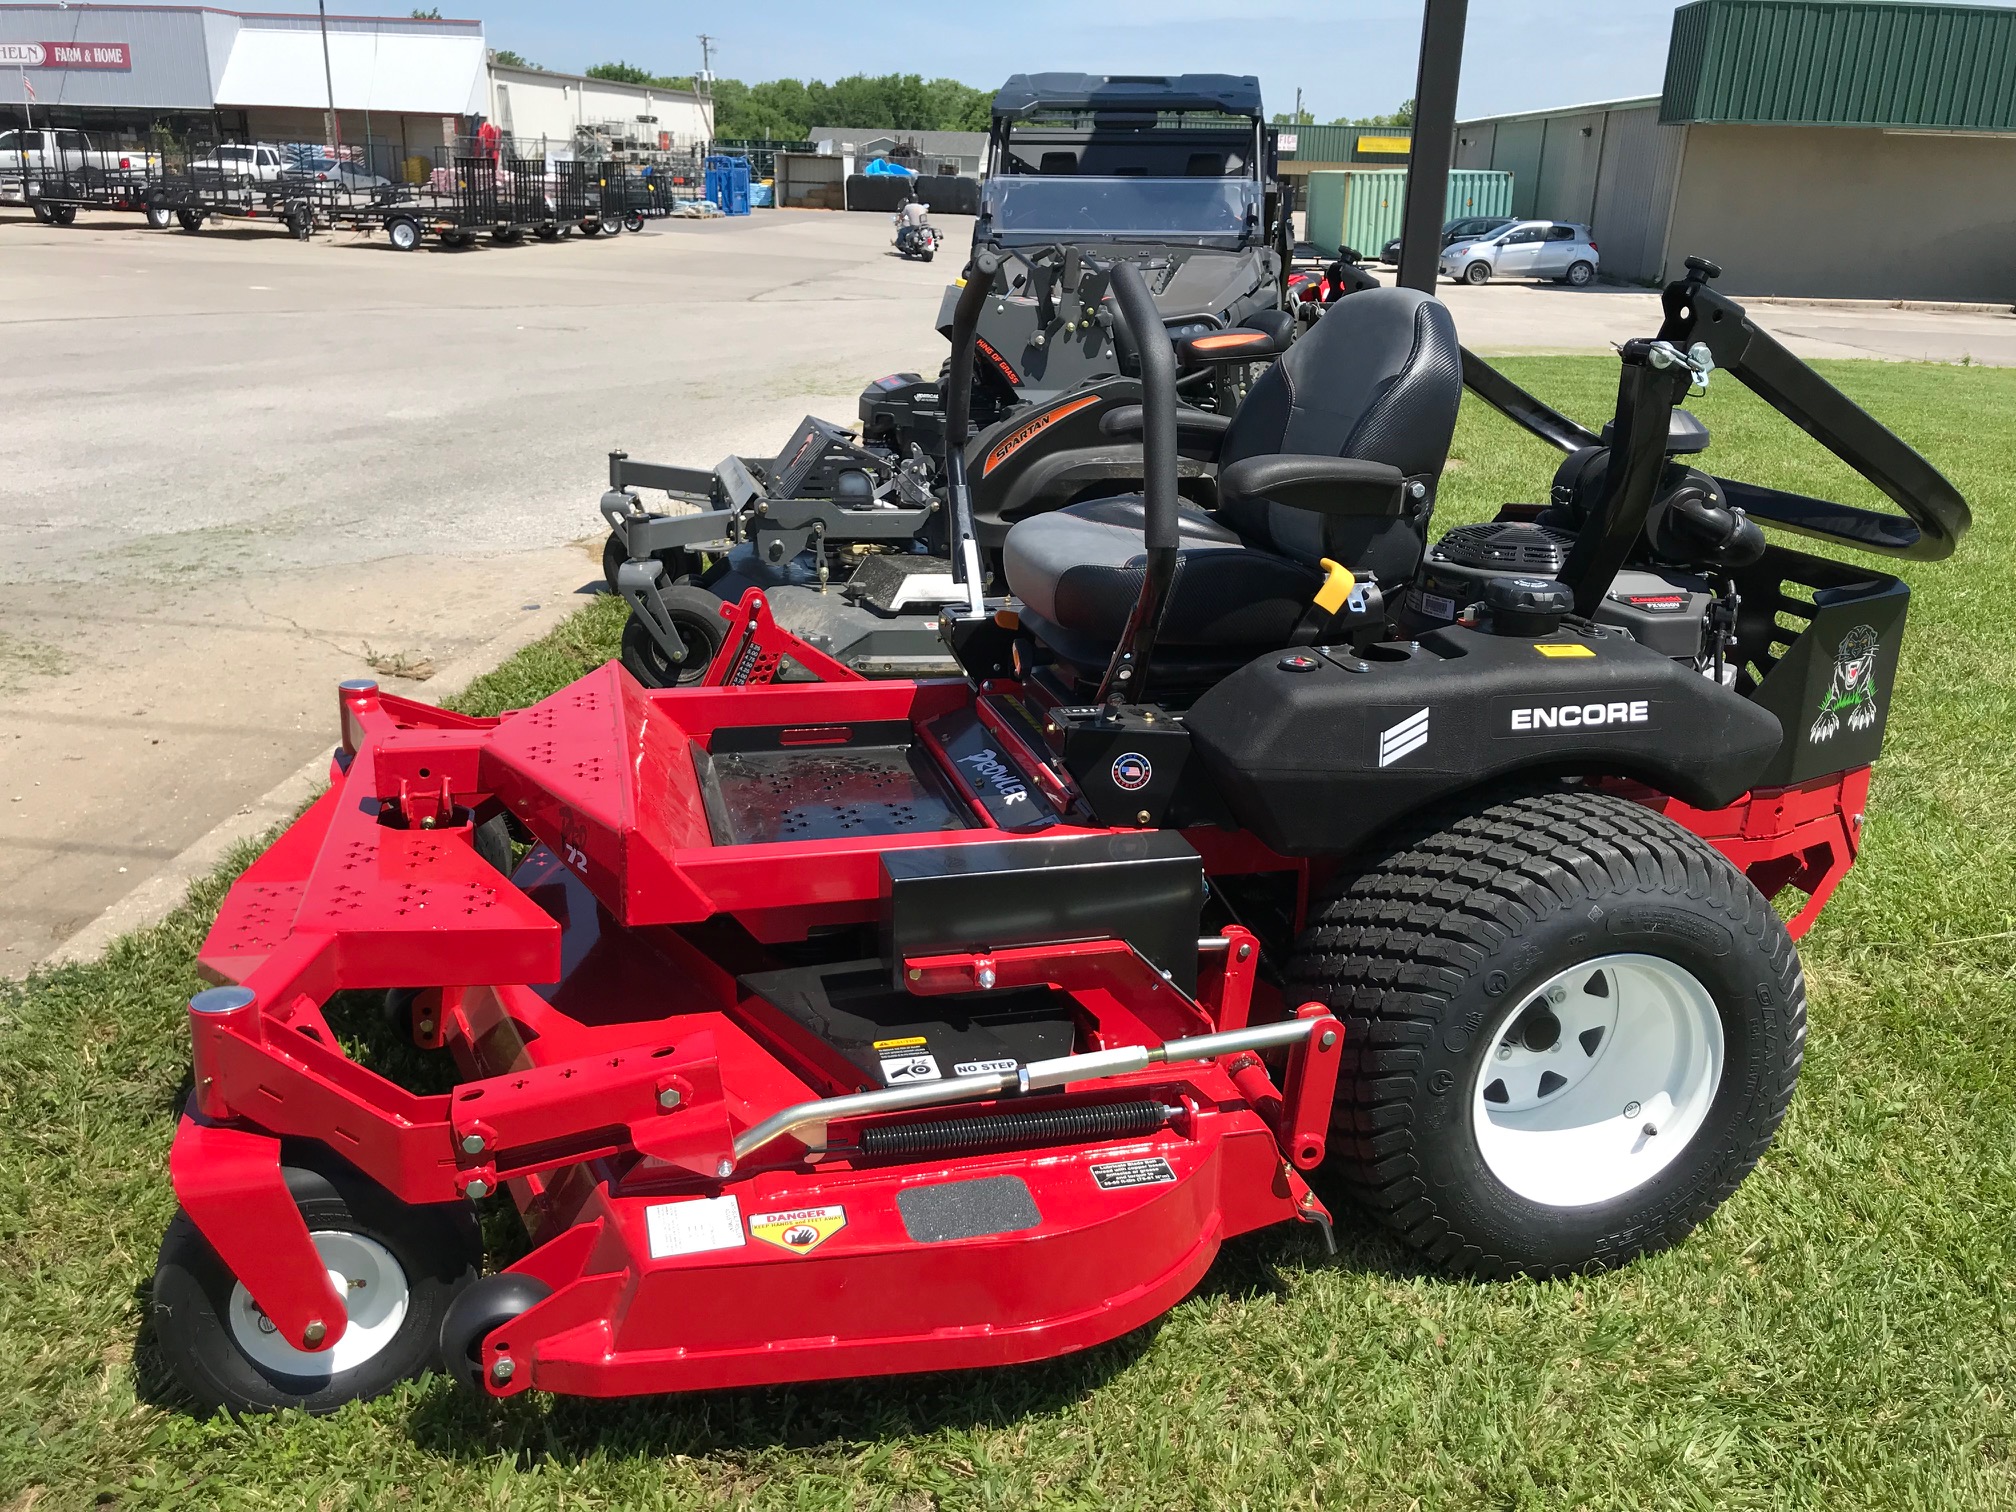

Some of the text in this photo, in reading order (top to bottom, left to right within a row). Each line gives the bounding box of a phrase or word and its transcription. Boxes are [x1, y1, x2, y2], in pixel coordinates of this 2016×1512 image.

[54, 47, 82, 62] FARM
[84, 50, 91, 62] &
[94, 48, 123, 63] HOME
[976, 339, 1019, 384] KING OF GRASS
[996, 415, 1050, 460] SPARTAN
[1512, 701, 1648, 730] ENCORE
[957, 748, 1028, 806] PROWLER
[566, 843, 587, 873] 72
[957, 1061, 1014, 1073] NO STEP
[766, 1210, 825, 1222] DANGER
